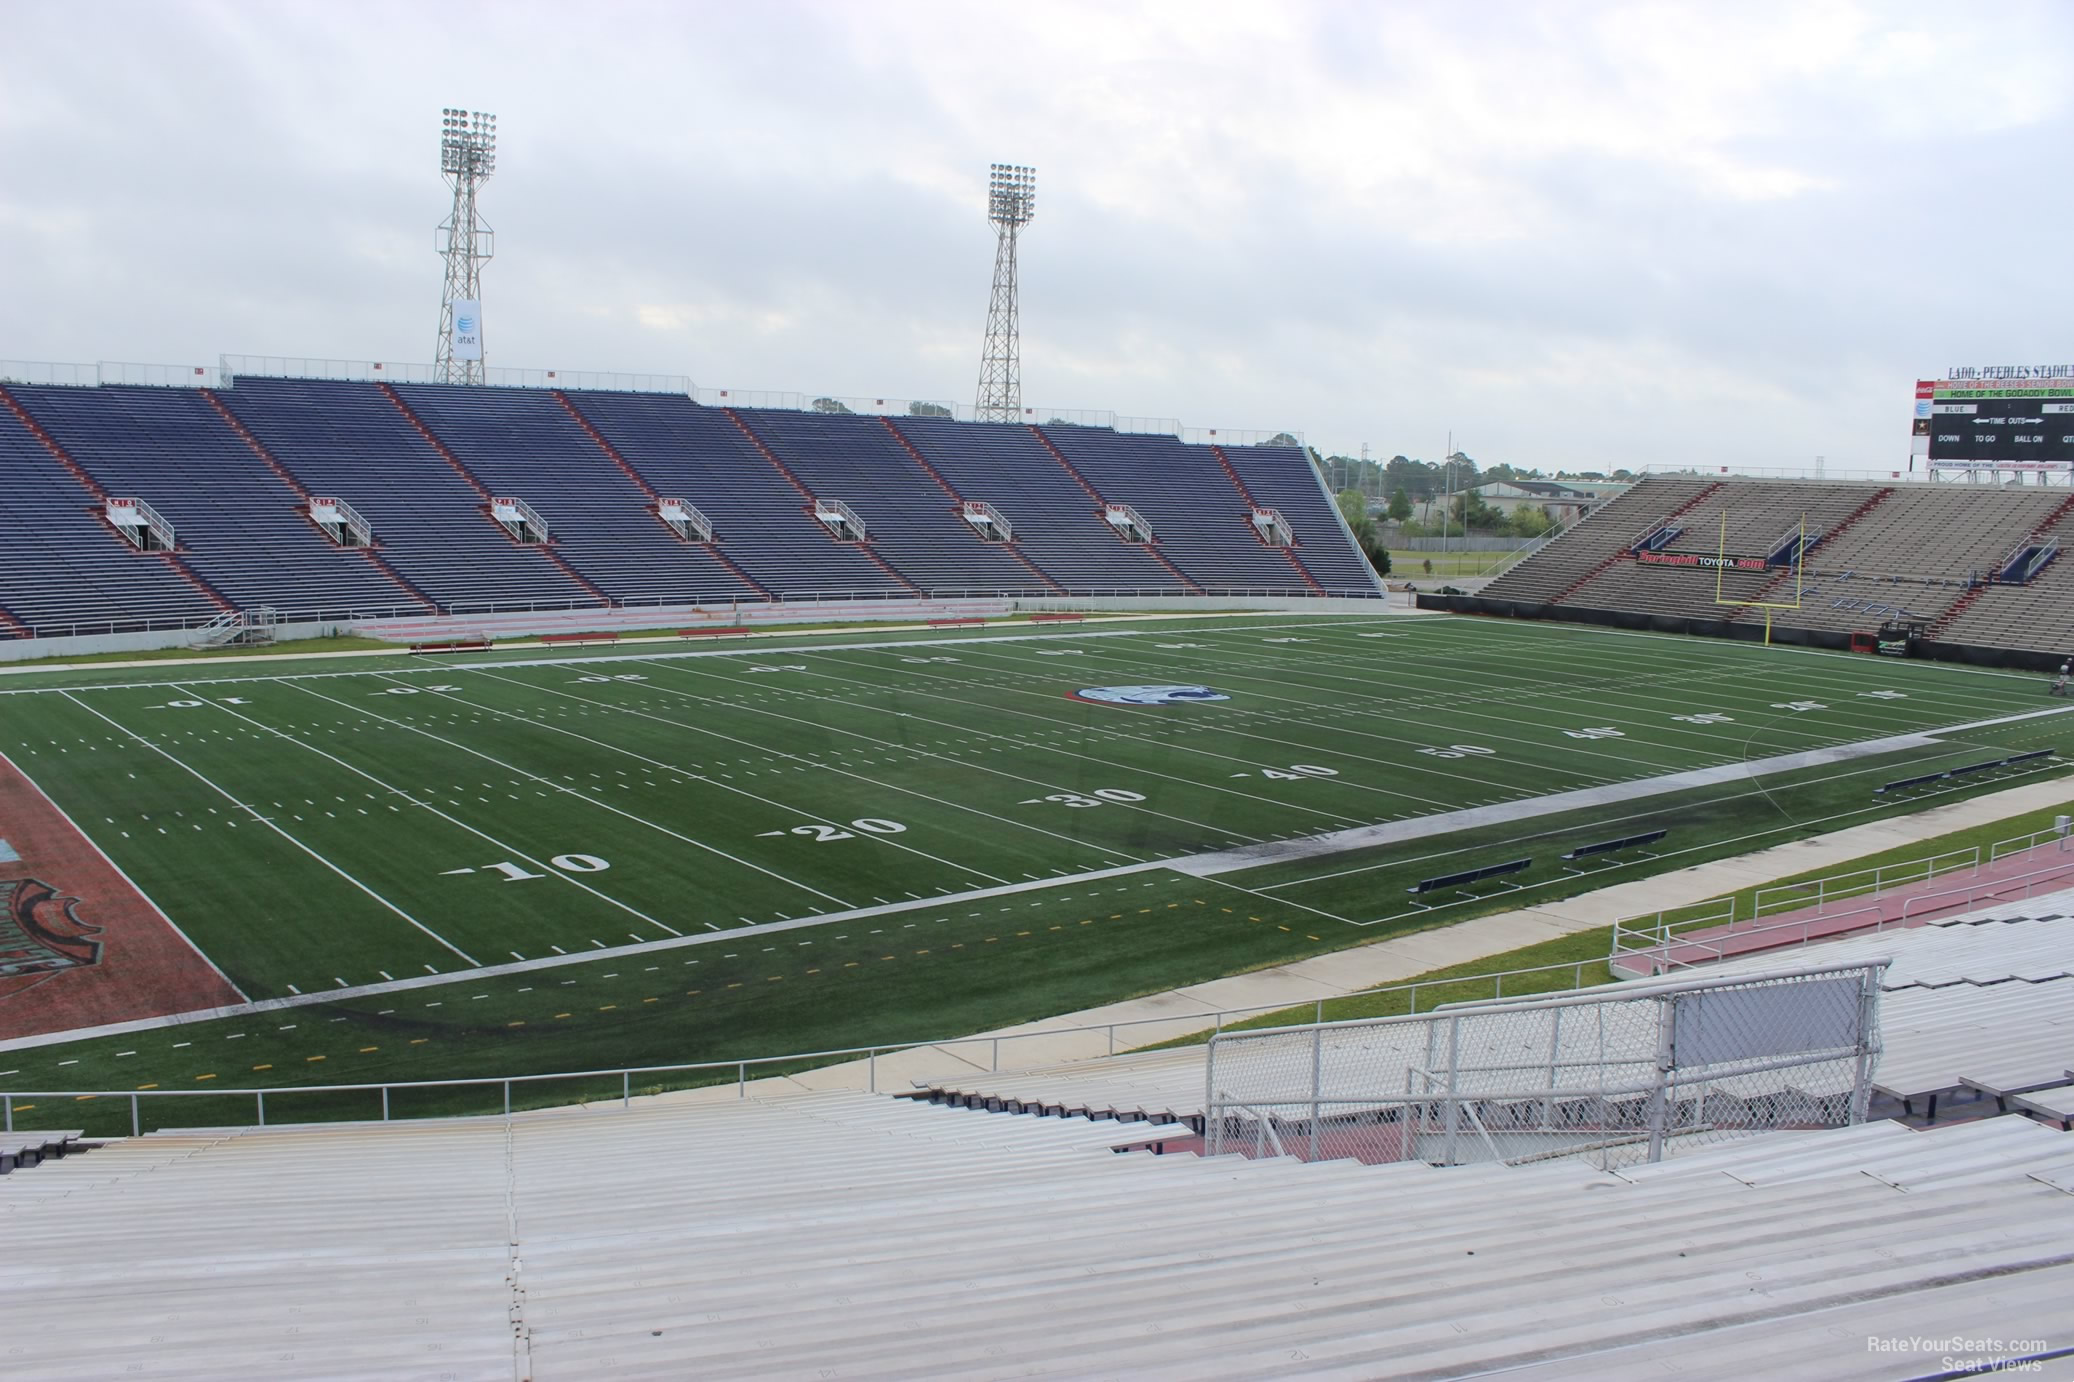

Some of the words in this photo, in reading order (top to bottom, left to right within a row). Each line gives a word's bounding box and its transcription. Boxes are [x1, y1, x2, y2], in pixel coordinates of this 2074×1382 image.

[457, 336, 475, 344] at&t
[1983, 366, 2030, 379] PEEBLES
[1951, 390, 1973, 398] HOME
[1975, 390, 1985, 398] OF
[1989, 390, 2003, 398] THE
[2048, 388, 2072, 397] BOWL
[1698, 557, 1735, 567] TOYOTA
[1415, 744, 1497, 759] 50
[1261, 764, 1340, 781] 40
[1045, 788, 1147, 808] 30
[790, 818, 907, 842] 20
[482, 854, 611, 882] 10
